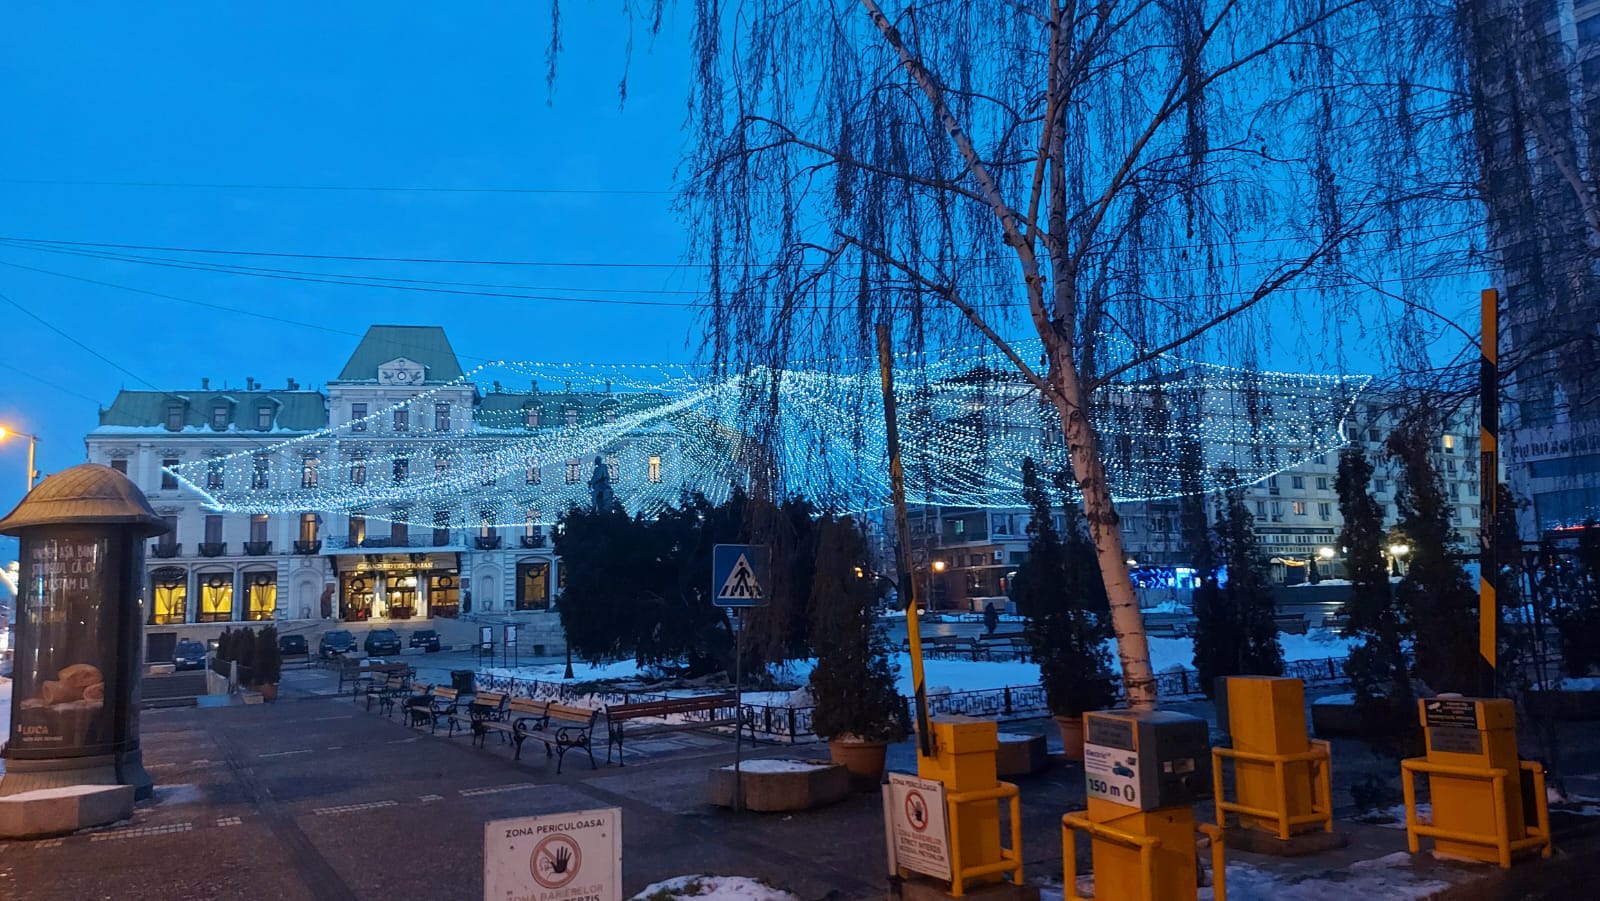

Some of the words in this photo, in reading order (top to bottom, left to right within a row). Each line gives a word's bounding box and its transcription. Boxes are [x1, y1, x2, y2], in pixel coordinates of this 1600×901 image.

[22, 725, 49, 735] LUCA
[1088, 778, 1107, 794] 150
[1110, 785, 1121, 797] m
[505, 826, 534, 838] ZONA
